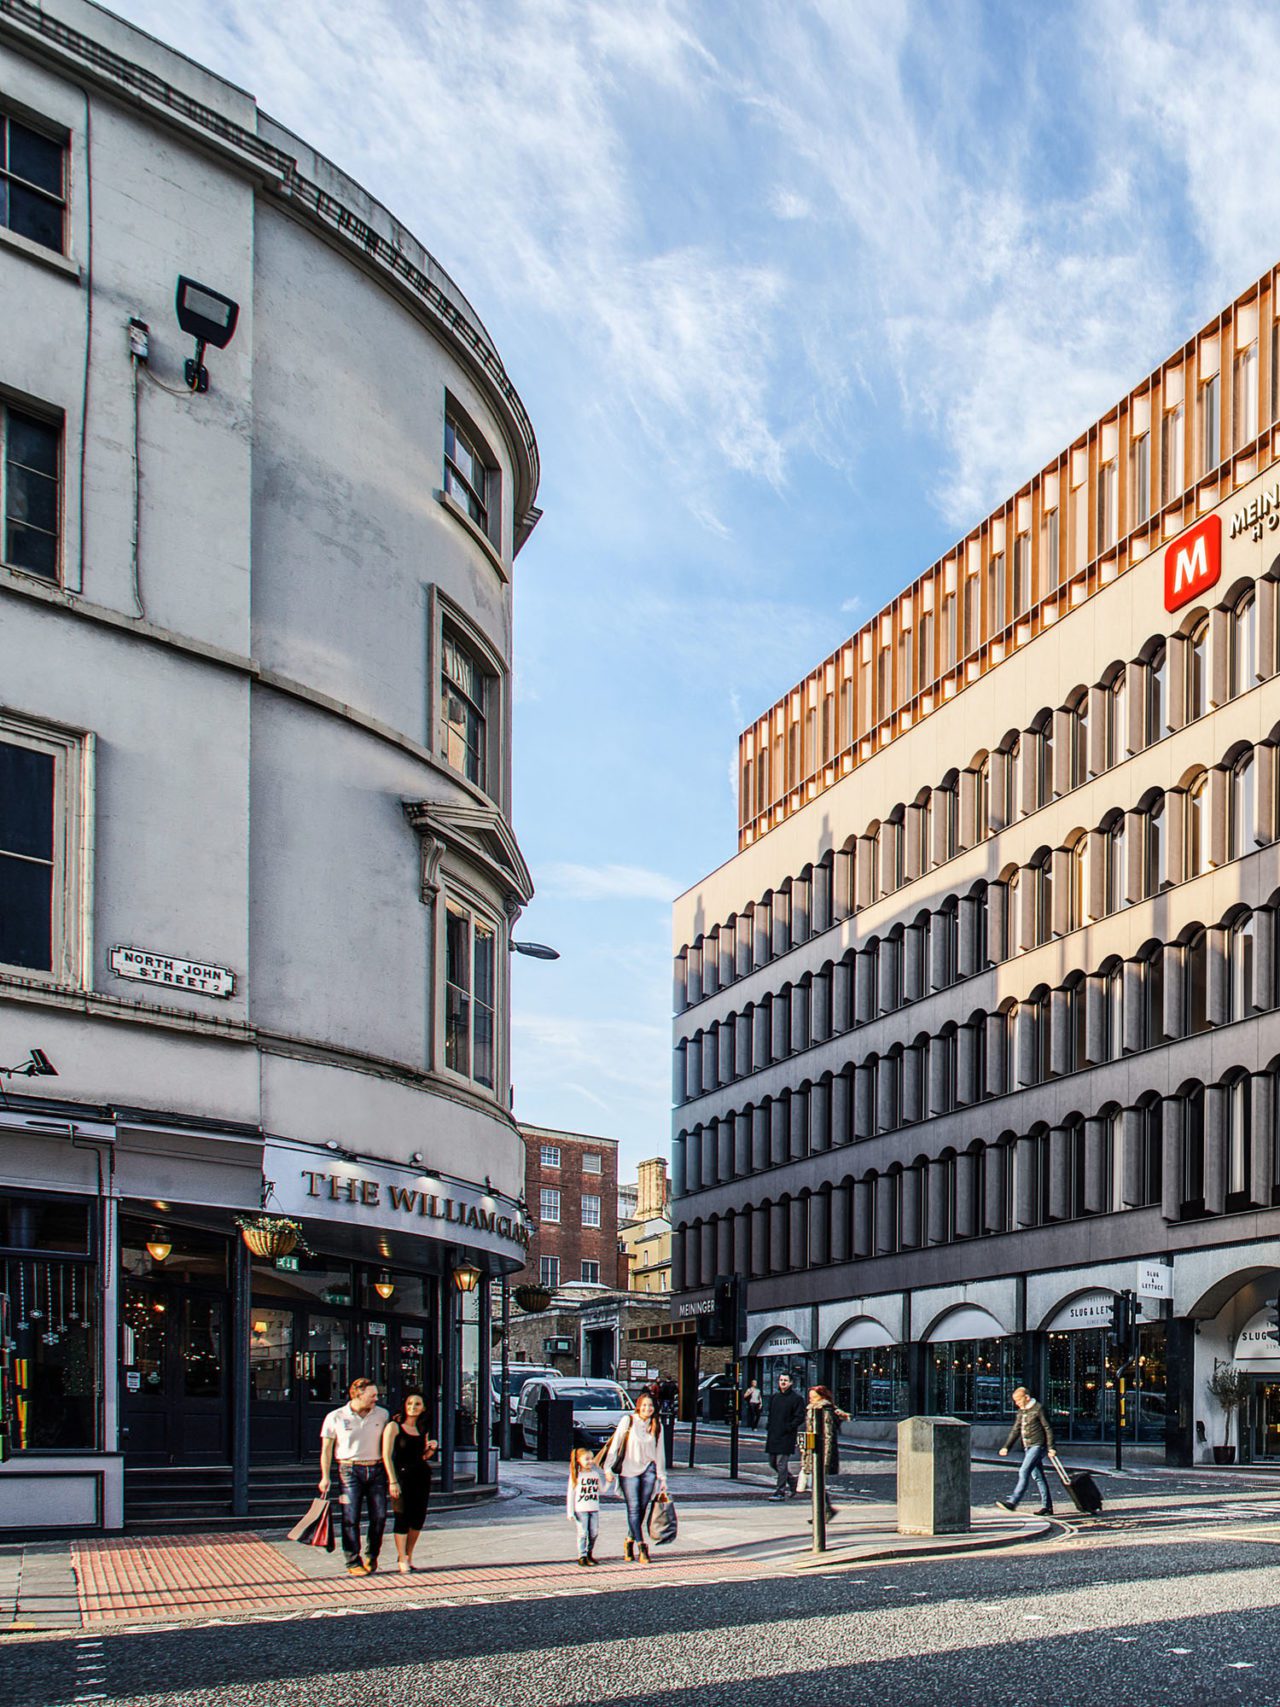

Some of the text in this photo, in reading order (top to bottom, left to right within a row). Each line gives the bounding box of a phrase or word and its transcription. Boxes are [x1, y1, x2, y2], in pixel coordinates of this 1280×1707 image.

[1174, 535, 1208, 594] M
[124, 952, 221, 980] NORTH JOHN
[140, 967, 207, 989] STREET
[301, 1169, 380, 1207] THE
[389, 1184, 497, 1233] WILLIAM
[1146, 1270, 1160, 1278] SLUG
[1141, 1282, 1164, 1292] LETTUCE
[679, 1299, 715, 1317] MEININGER
[1070, 1307, 1088, 1318] SLUG
[1089, 1304, 1094, 1316] &
[1242, 1332, 1267, 1341] SLUG
[581, 1478, 599, 1486] LOVE
